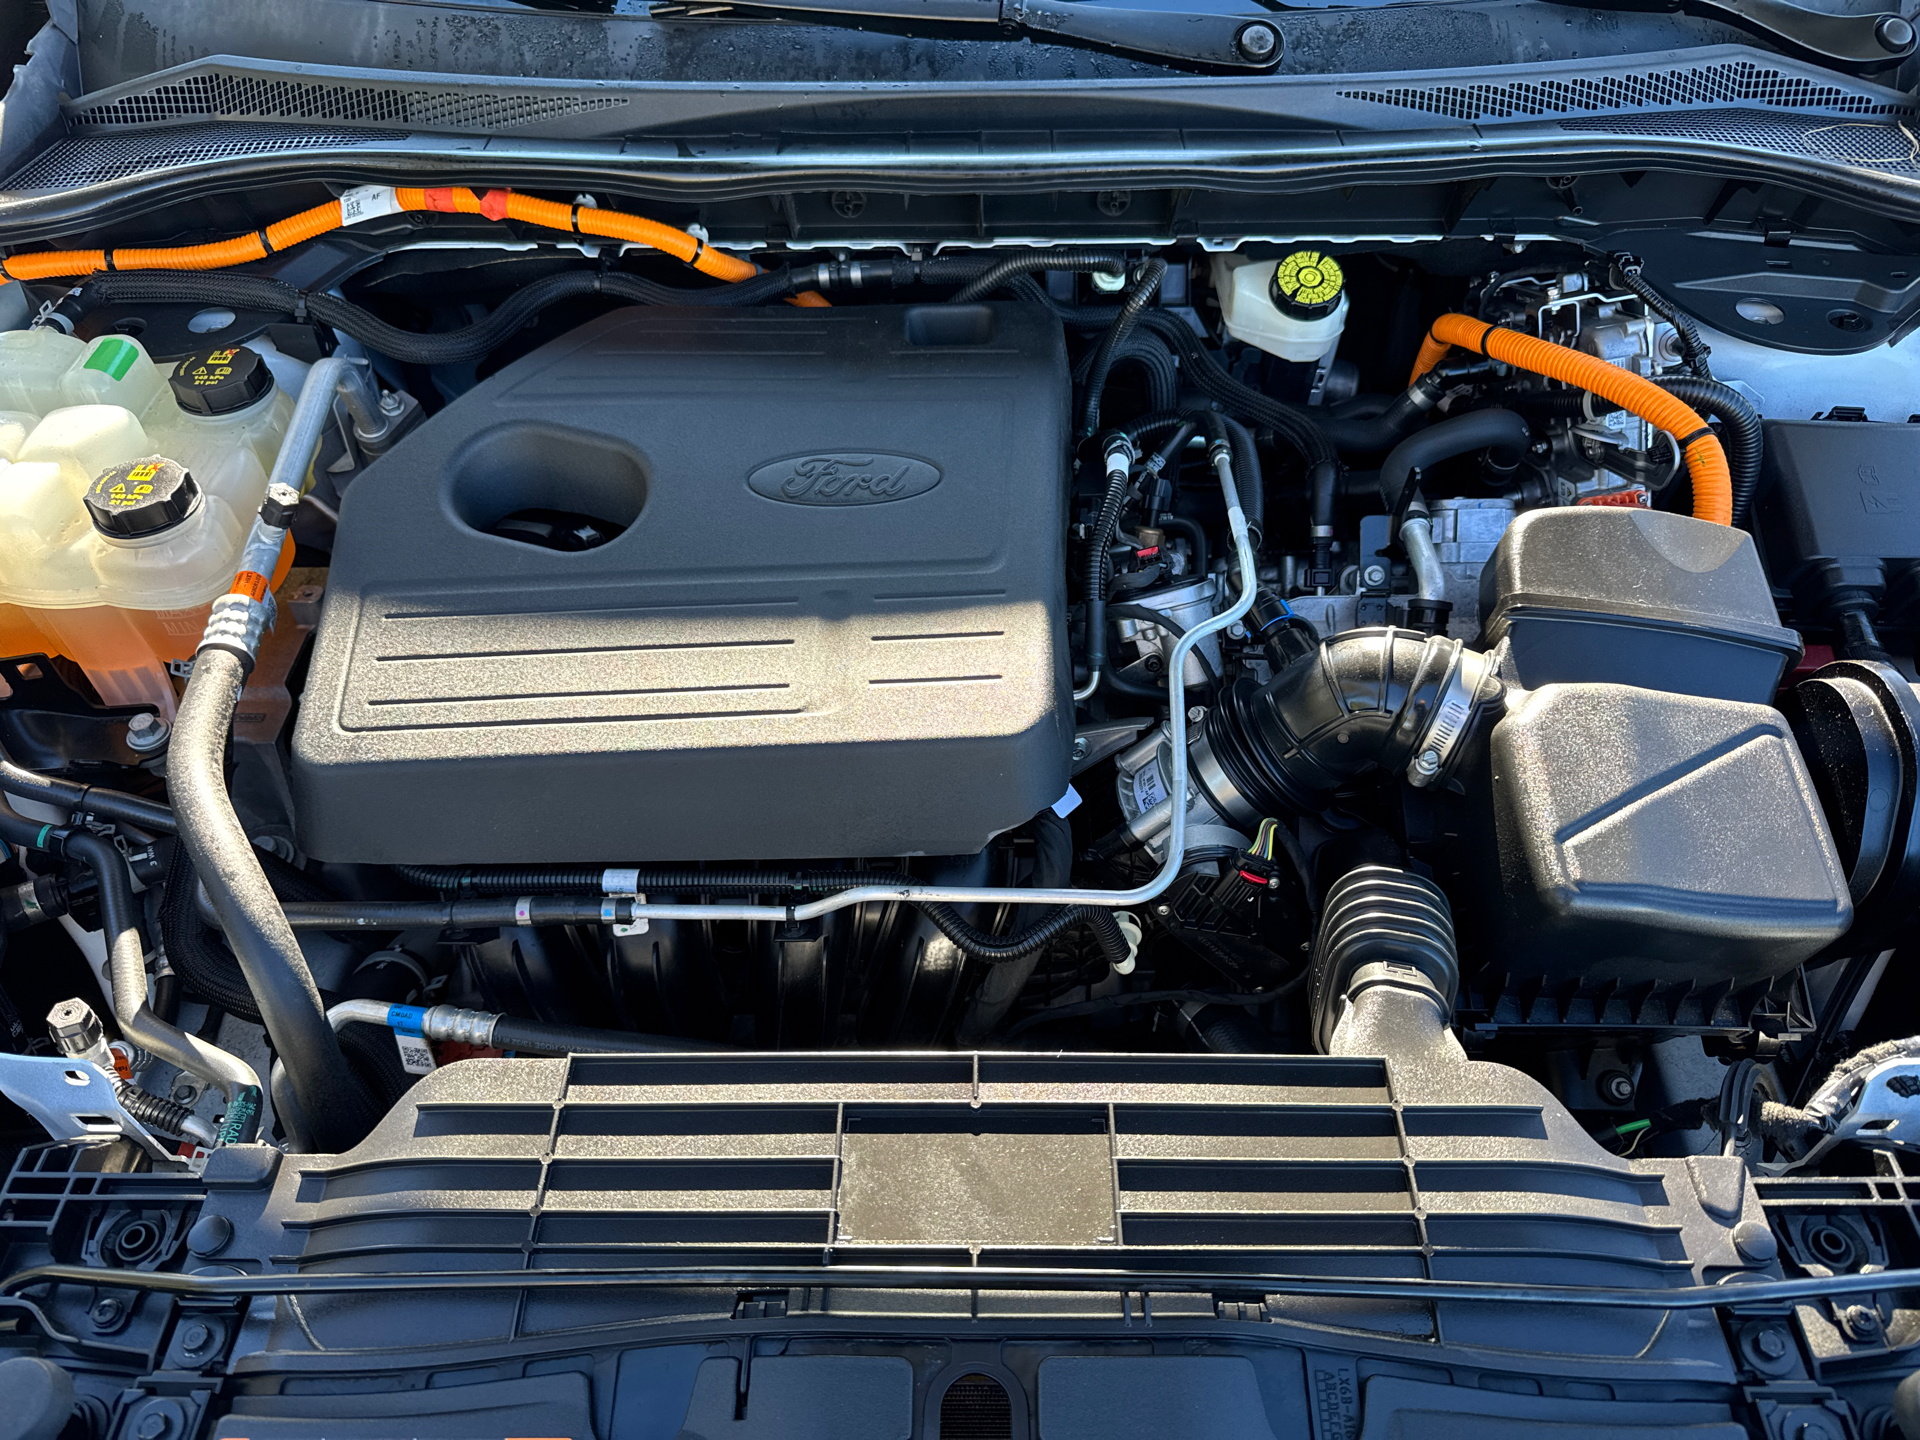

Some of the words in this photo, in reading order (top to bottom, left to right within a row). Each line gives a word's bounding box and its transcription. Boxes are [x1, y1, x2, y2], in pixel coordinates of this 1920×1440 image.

[371, 193, 381, 201] AF
[781, 457, 910, 497] Ford
[162, 621, 200, 634] MIN
[147, 845, 156, 860] WAY
[535, 1041, 558, 1050] HOSE
[225, 1122, 242, 1144] RAD
